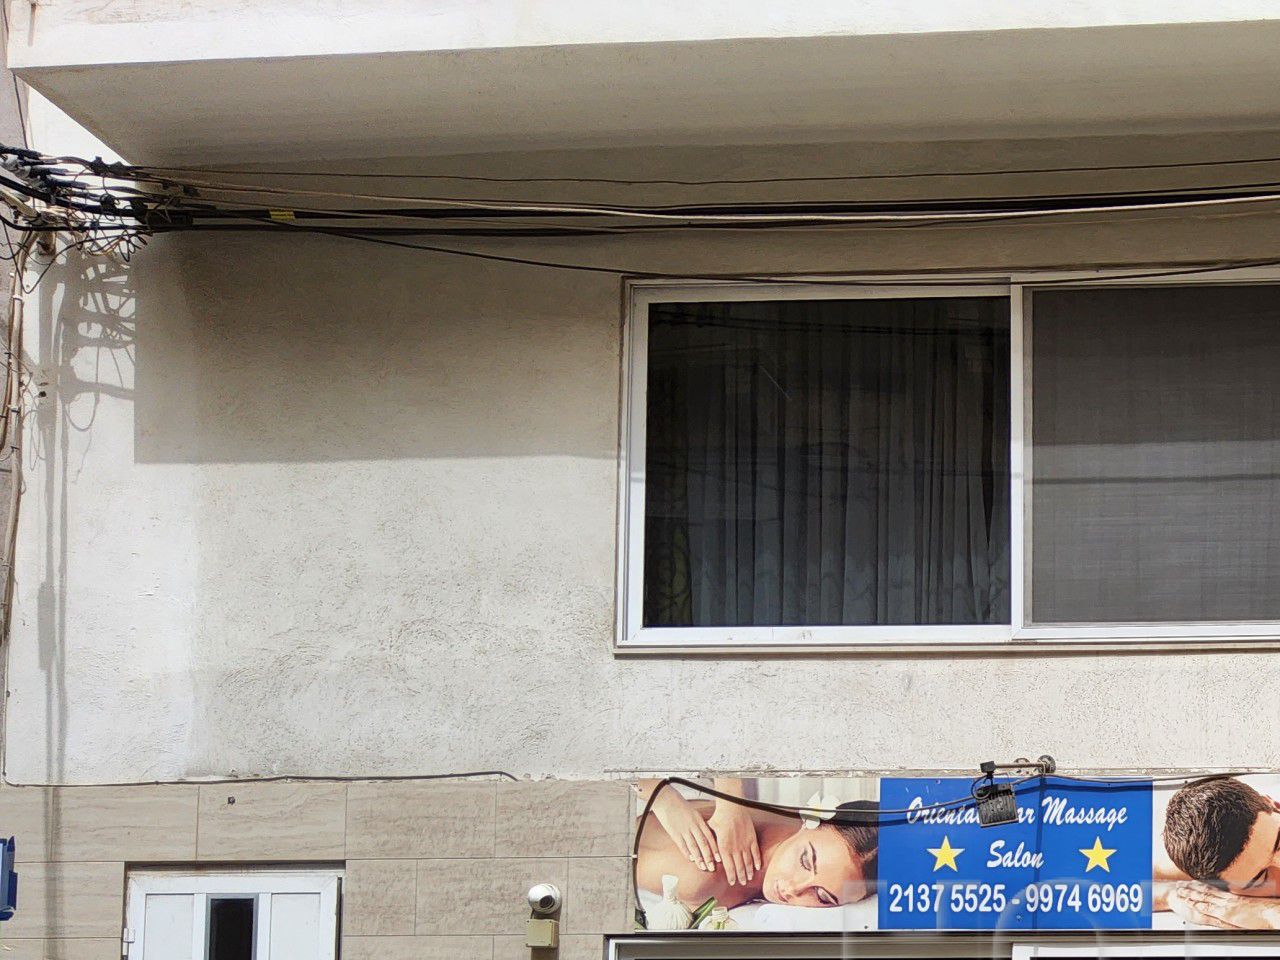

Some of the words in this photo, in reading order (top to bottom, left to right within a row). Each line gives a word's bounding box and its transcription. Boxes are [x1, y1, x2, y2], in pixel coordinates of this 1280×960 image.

[907, 796, 981, 825] Orienta
[1042, 796, 1127, 831] Massage
[987, 840, 1044, 868] Salon
[889, 884, 944, 913] 2137
[951, 884, 1006, 913] 5525
[1026, 884, 1082, 913] 9974
[1088, 884, 1143, 913] 6969
